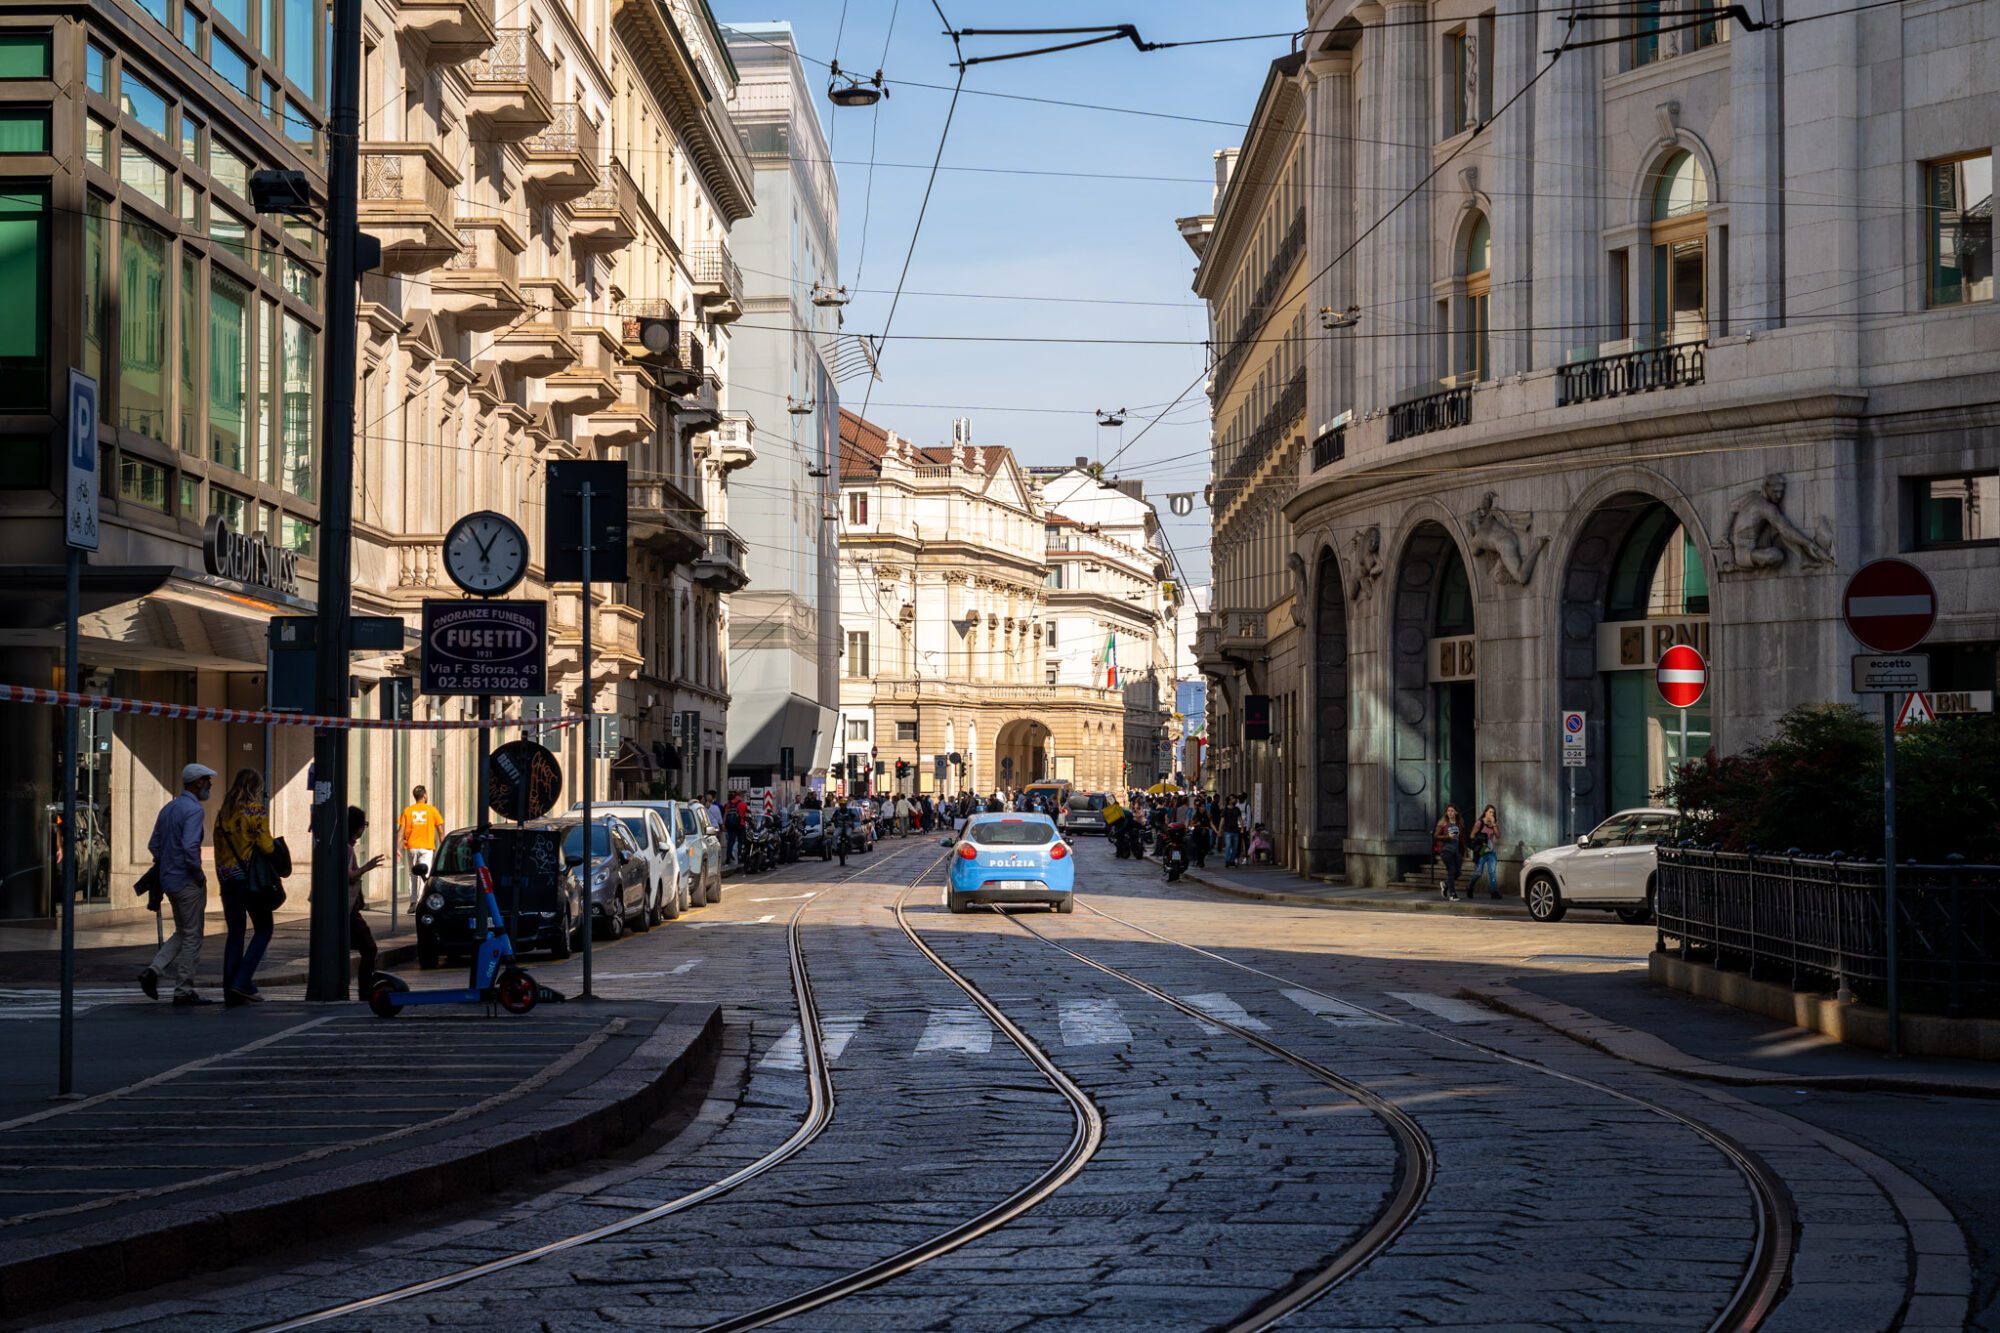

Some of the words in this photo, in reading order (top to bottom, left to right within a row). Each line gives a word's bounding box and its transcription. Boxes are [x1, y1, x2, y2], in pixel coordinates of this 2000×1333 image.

[77, 395, 91, 458] P
[206, 514, 260, 584] CREDIT
[432, 608, 489, 629] ONORANZE
[491, 609, 536, 630] FUNEBRI
[446, 629, 522, 648] FUSETTI
[429, 663, 450, 674] Via
[455, 664, 467, 674] F.
[471, 664, 518, 675] Sforza,
[521, 665, 538, 675] 43
[1870, 659, 1912, 668] eccetto
[438, 676, 529, 689] 02.5513026
[1936, 693, 1977, 712] BNL
[989, 859, 1036, 868] POLIZIA
